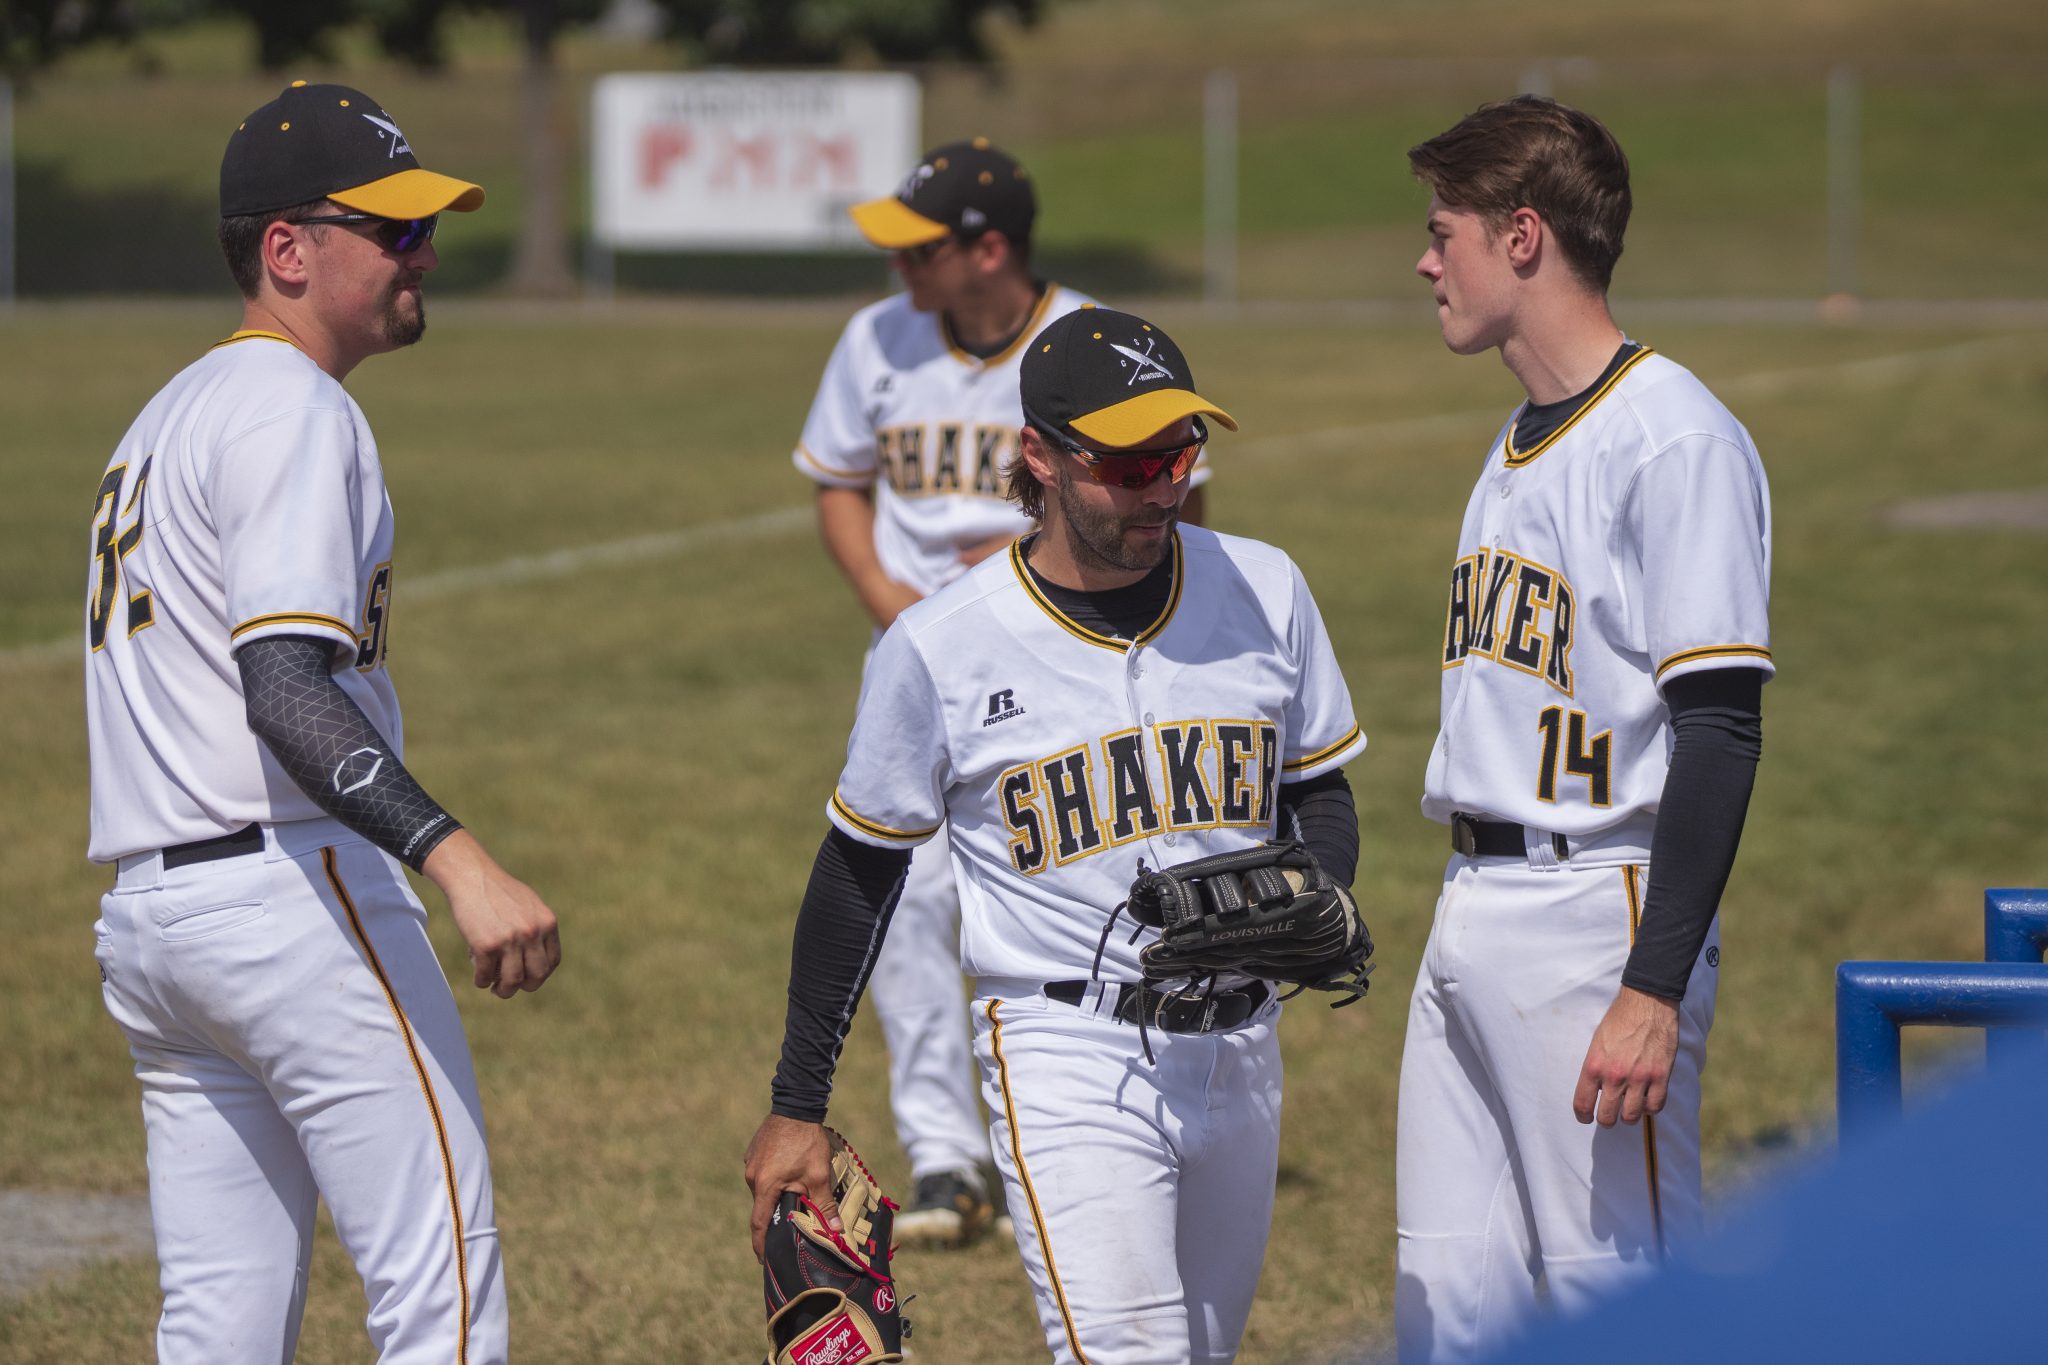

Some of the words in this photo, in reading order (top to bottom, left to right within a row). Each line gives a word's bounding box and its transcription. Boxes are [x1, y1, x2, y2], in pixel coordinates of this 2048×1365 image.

[1442, 545, 1576, 700] HKER
[983, 706, 1027, 728] RUSSELL
[1537, 704, 1612, 809] 14
[998, 719, 1278, 876] SHAKER
[1211, 919, 1296, 942] LOUISVILLE
[805, 1328, 852, 1365] Rawlings
